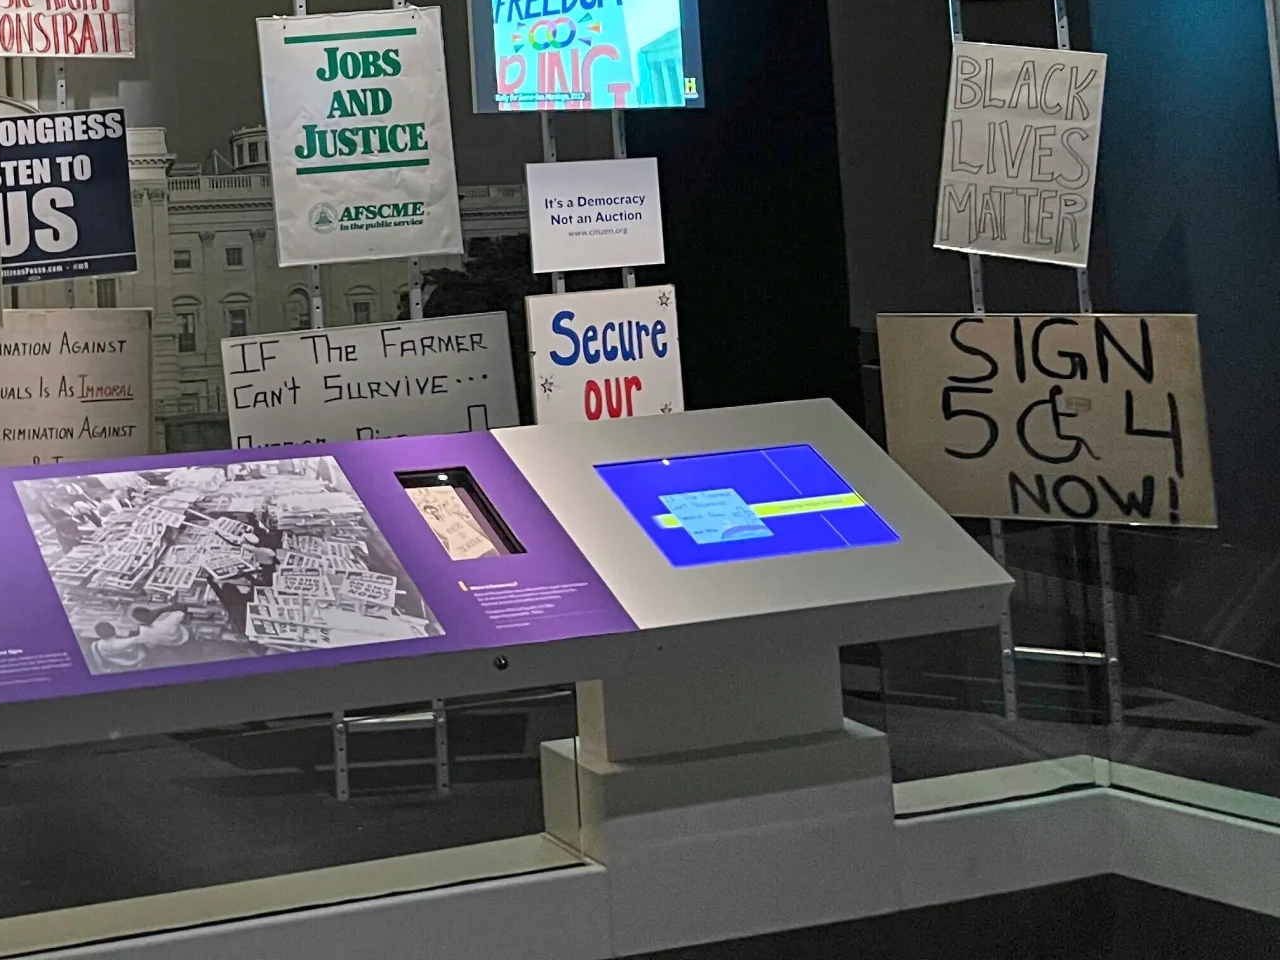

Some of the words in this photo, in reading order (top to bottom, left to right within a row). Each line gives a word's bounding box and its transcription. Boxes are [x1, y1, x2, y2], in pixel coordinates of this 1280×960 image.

[316, 47, 401, 81] JOBS
[498, 44, 632, 110] RING
[327, 88, 392, 119] AND
[953, 55, 1097, 120] BLACK
[295, 123, 429, 159] JUSTICE
[951, 120, 1090, 189] LIVES
[60, 155, 91, 181] TO
[338, 202, 424, 222] AFSCME
[545, 198, 563, 209] It's
[577, 194, 646, 208] Democracy
[550, 214, 573, 225] Not
[577, 215, 592, 223] an
[595, 211, 642, 222] Auction
[940, 183, 1088, 254] MATTER
[366, 220, 392, 231] public
[393, 219, 423, 228] service
[568, 227, 628, 237] www.citizen.org
[230, 340, 280, 374] IF
[301, 334, 358, 363] The
[549, 311, 667, 366] Secure
[947, 317, 1154, 383] SIGN
[584, 375, 642, 420] our
[1008, 471, 1180, 524] NOW!
